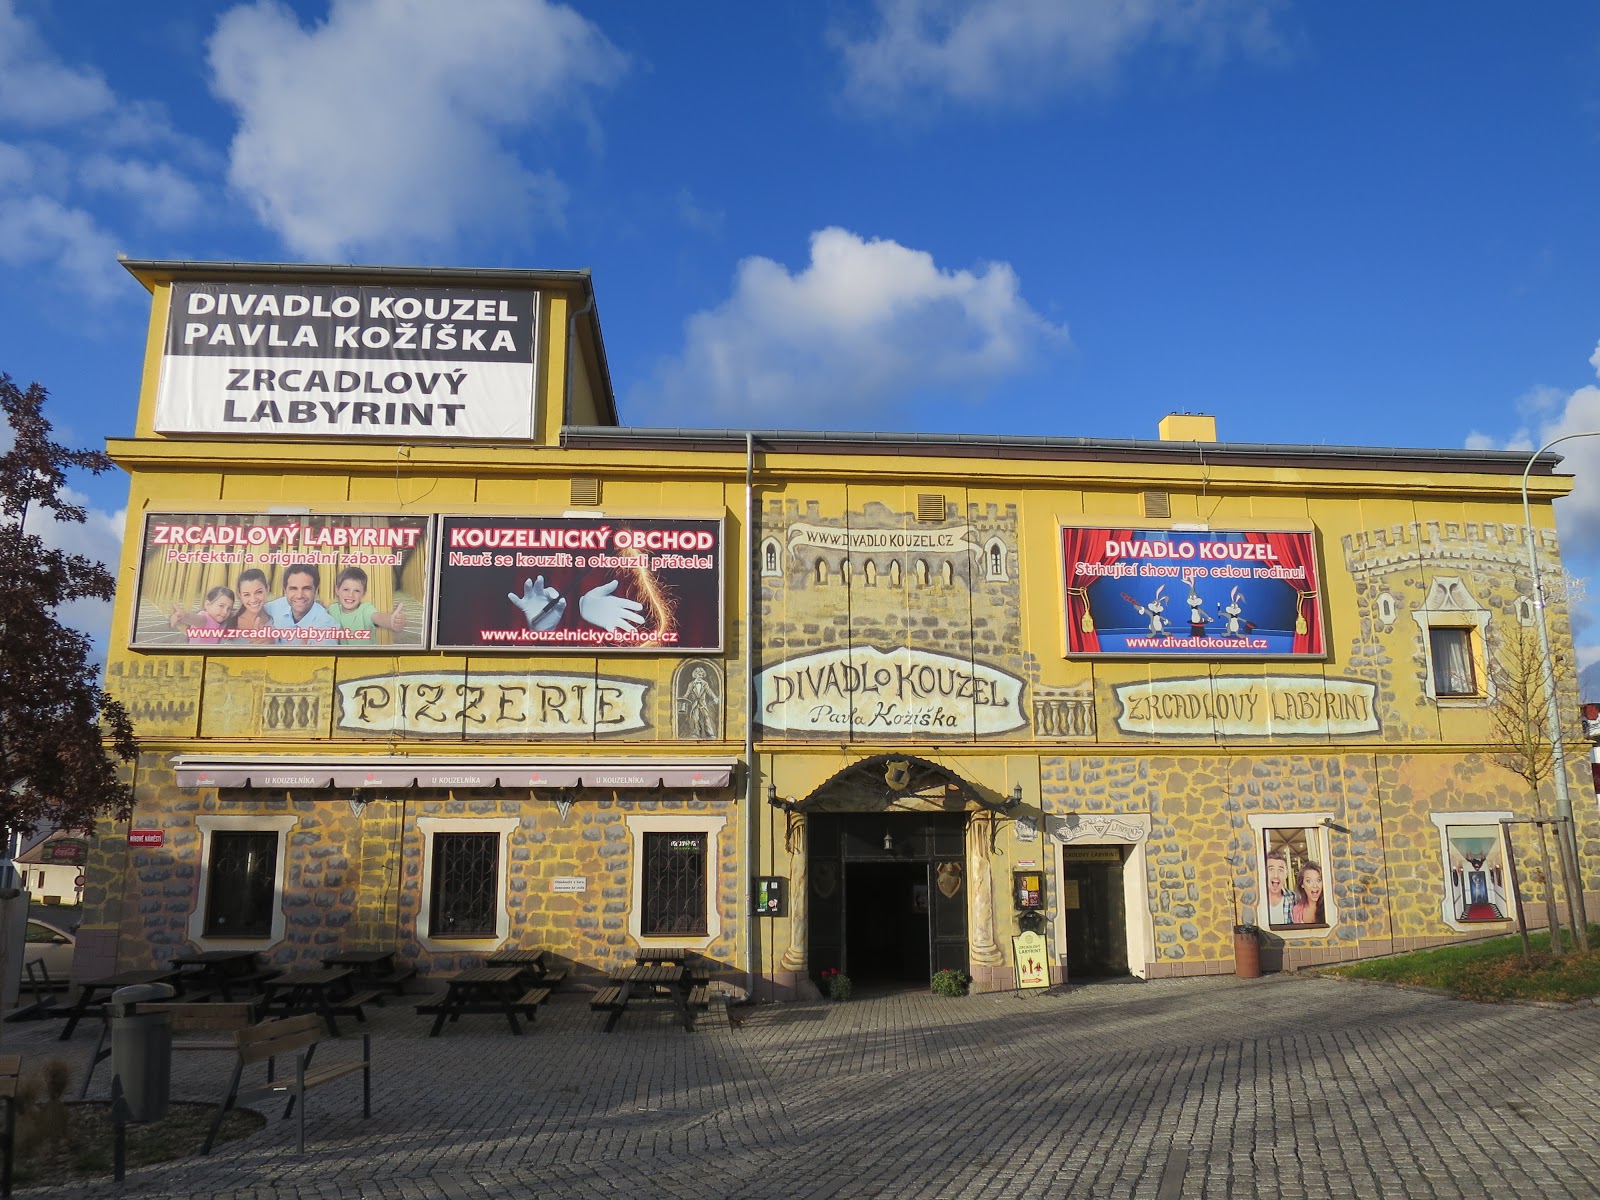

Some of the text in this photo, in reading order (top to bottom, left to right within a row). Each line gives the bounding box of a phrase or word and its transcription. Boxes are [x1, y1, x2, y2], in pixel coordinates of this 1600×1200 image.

[187, 292, 517, 322] DIVADLO KOUZEL
[184, 321, 517, 352] PAVLA KOŽÍŠKA
[226, 367, 468, 395] ZRCADLOVÝ
[223, 400, 466, 426] LABYRINT
[153, 523, 420, 547] ZRCADLOVÝ LABYRINT
[451, 526, 714, 550] KOUZELNICKÝ OBCHOD
[167, 549, 402, 566] Perfektní a originální zábava!
[1105, 540, 1278, 560] DIVADLO KOUZEL
[449, 552, 712, 571] Nauč se kouzlit a okouzli přátele!
[1075, 562, 1305, 580] Strhující show pro celou rodinu!
[187, 626, 371, 642] www.zrcadlovylabyrint.cz
[480, 628, 678, 643] www.kouzelnickyobchod.cz
[1126, 637, 1268, 650] www.divadlokouzel.cz
[766, 661, 1009, 713] DIVADLO KOUZEL
[354, 683, 625, 725] PIZZERIE
[1128, 685, 1370, 722] ZRCADLOVÝ LABYRINT
[809, 702, 958, 728] Pavla Kožíška
[272, 776, 315, 784] KOUZELNÍKA
[439, 776, 480, 784] KOUZELNÍKA
[603, 776, 644, 784] KOUZELNÍKA
